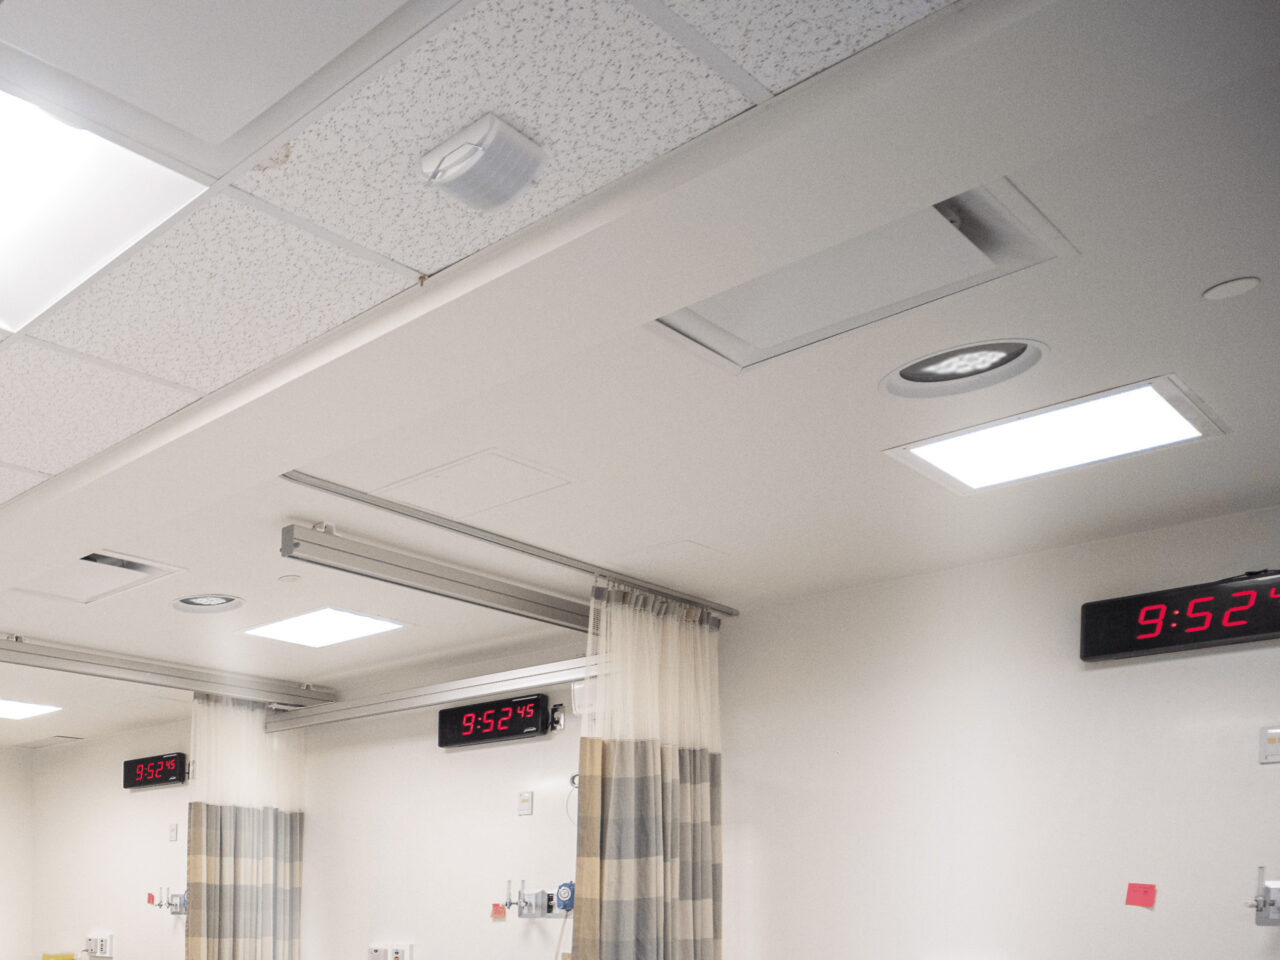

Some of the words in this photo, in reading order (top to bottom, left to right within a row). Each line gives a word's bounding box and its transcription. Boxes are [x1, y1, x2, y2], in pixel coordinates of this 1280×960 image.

[1136, 590, 1257, 640] 9:52
[461, 707, 513, 736] 9:52
[516, 703, 535, 718] 45
[135, 761, 164, 781] 9:52
[165, 759, 176, 770] 45
